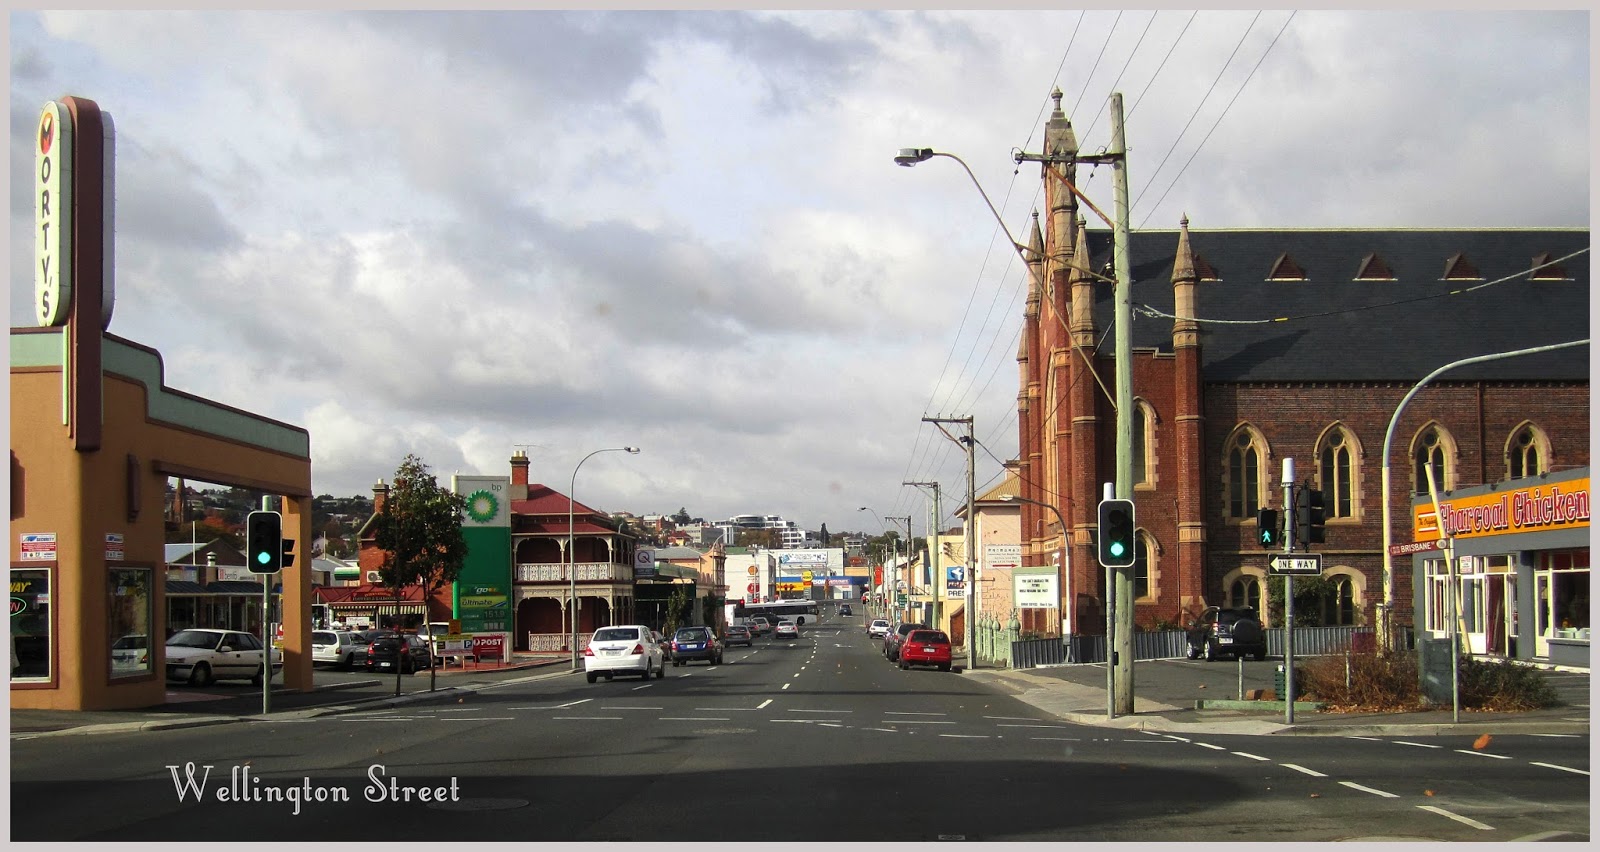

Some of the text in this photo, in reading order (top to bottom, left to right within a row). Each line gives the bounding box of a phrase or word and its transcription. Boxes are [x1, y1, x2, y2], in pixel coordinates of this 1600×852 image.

[40, 114, 54, 318] MORTY'S
[491, 483, 502, 492] bp
[1439, 487, 1590, 533] Charcoal Chicken
[1400, 541, 1432, 553] BRISBANE
[1278, 560, 1314, 568] ONE WAY
[480, 638, 502, 646] POST
